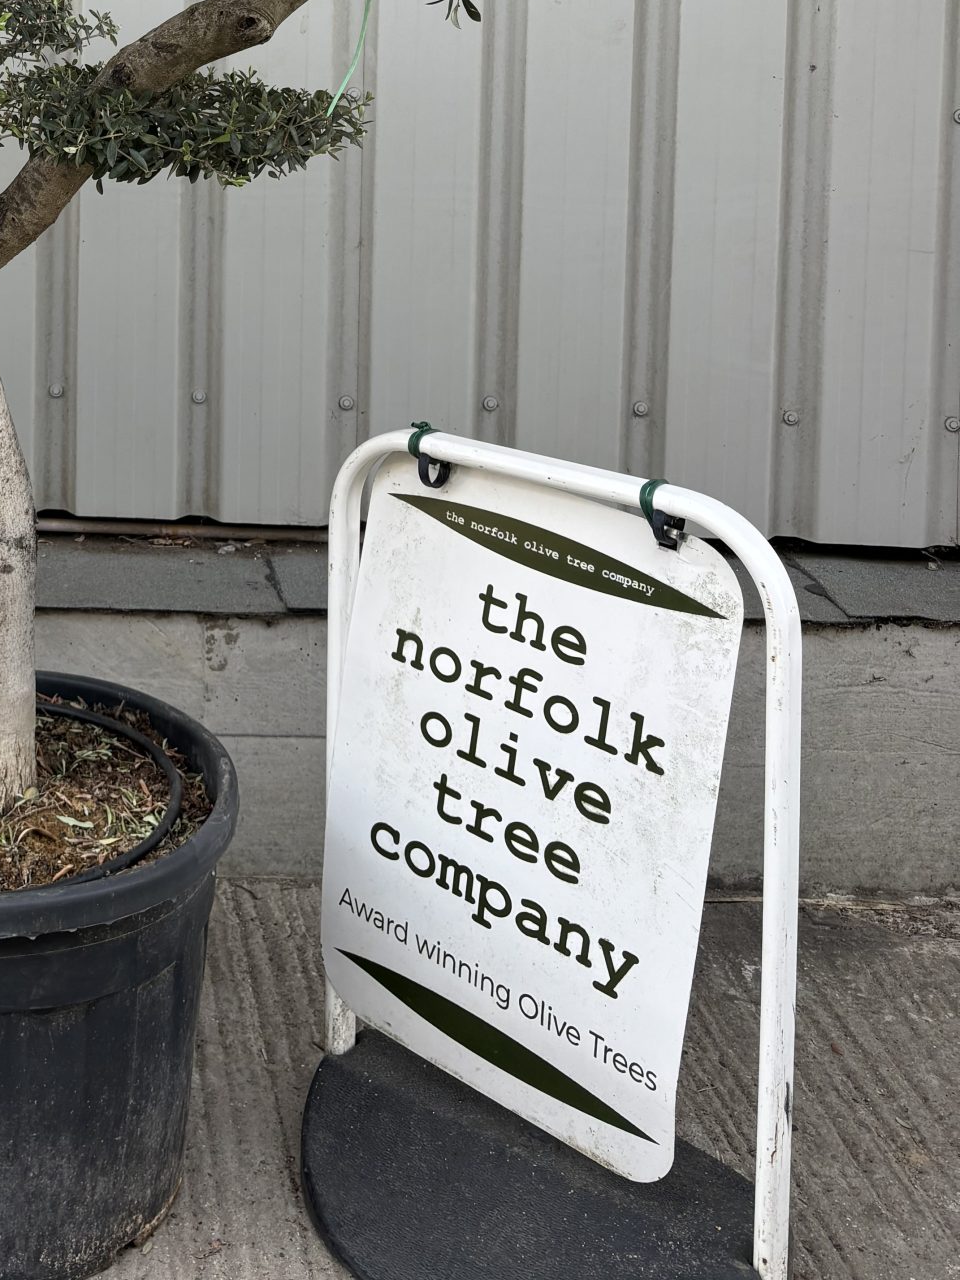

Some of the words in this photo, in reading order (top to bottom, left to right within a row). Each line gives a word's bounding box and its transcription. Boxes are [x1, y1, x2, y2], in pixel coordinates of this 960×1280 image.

[446, 510, 465, 526] the
[470, 521, 518, 545] norfolk
[524, 539, 560, 560] olive
[566, 554, 595, 573] tree
[602, 569, 655, 596] company
[479, 584, 587, 666] the
[391, 628, 666, 776] norfolk
[420, 711, 612, 825] olive
[433, 773, 581, 885] tree
[370, 821, 640, 1000] company
[338, 887, 409, 946] Award
[416, 933, 511, 1011] winning
[519, 993, 581, 1046] Olive
[589, 1029, 658, 1092] Trees
